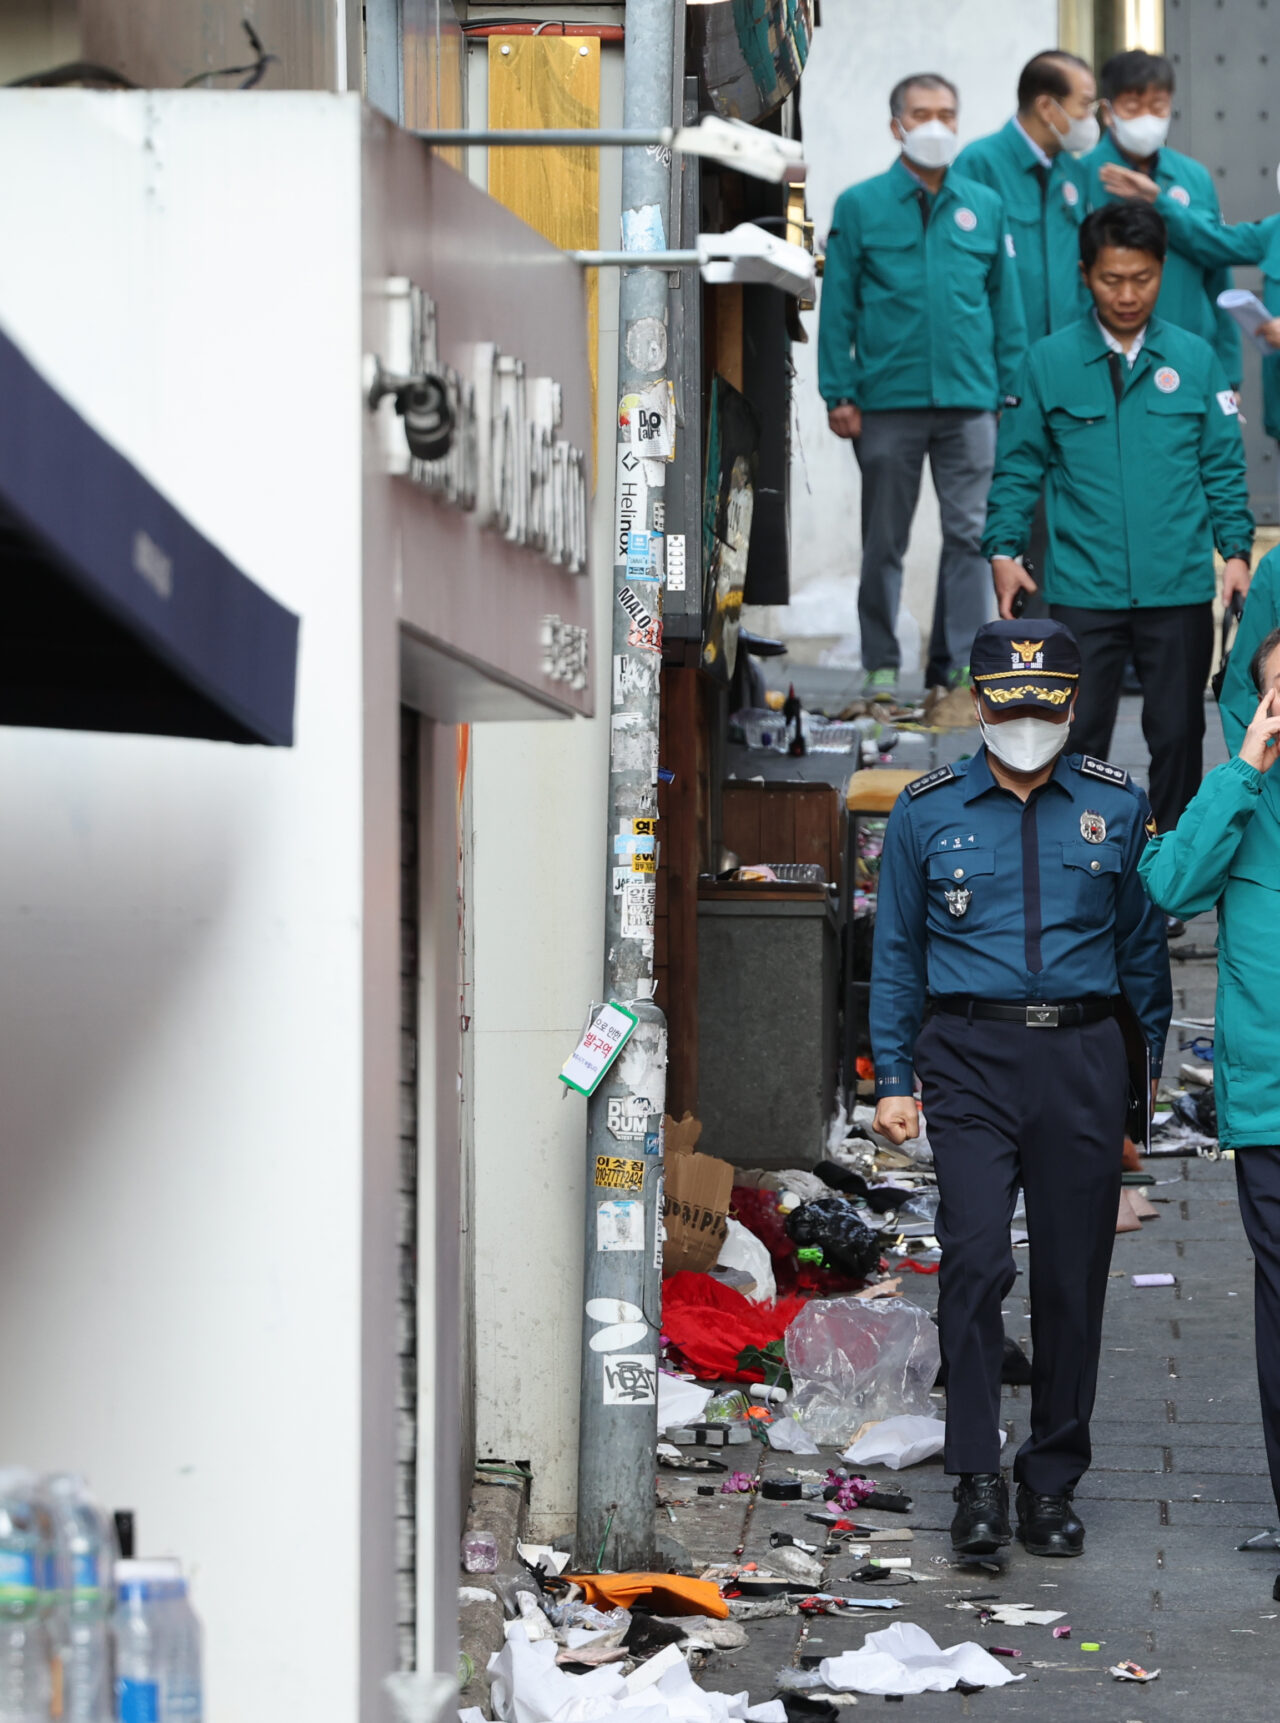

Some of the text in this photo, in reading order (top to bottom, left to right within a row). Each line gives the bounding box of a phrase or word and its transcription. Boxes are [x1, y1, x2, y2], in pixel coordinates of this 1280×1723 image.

[619, 482, 638, 556] Helinox
[618, 587, 652, 629] MALO
[608, 1116, 648, 1133] DUM
[597, 1156, 645, 1172] 이삿짐
[595, 1166, 643, 1186] 010-7777-2424
